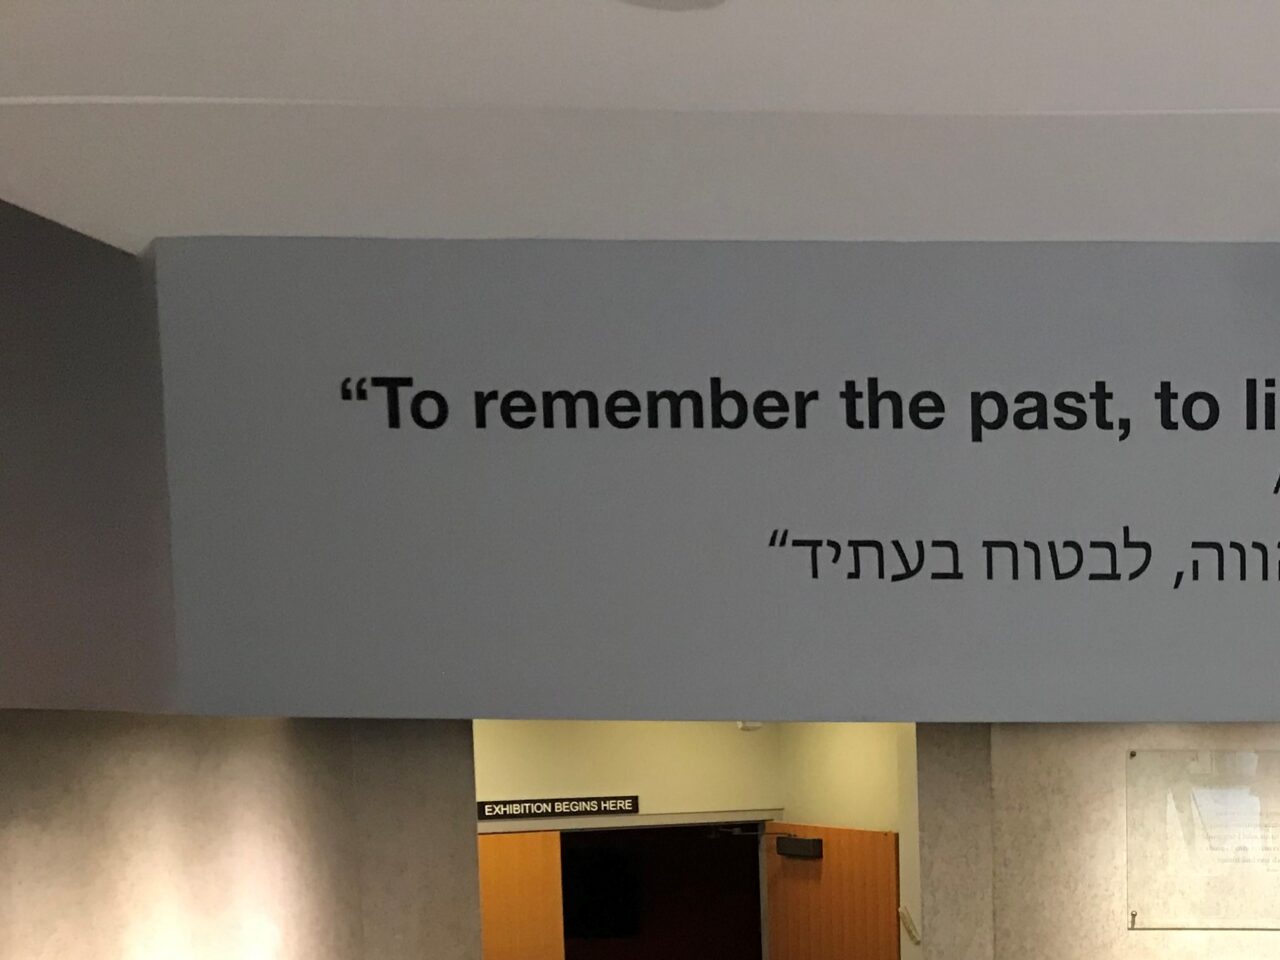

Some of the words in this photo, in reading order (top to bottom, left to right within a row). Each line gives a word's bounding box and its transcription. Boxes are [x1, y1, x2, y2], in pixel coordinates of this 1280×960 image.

[339, 376, 450, 430] “To
[474, 377, 819, 430] remember
[839, 377, 945, 430] the
[971, 381, 1130, 442] past,
[1154, 381, 1219, 431] to
[982, 526, 1152, 581] לבטוח
[484, 803, 552, 816] EXHIBITION
[554, 801, 599, 813] BEGINS
[601, 799, 633, 811] HERE
